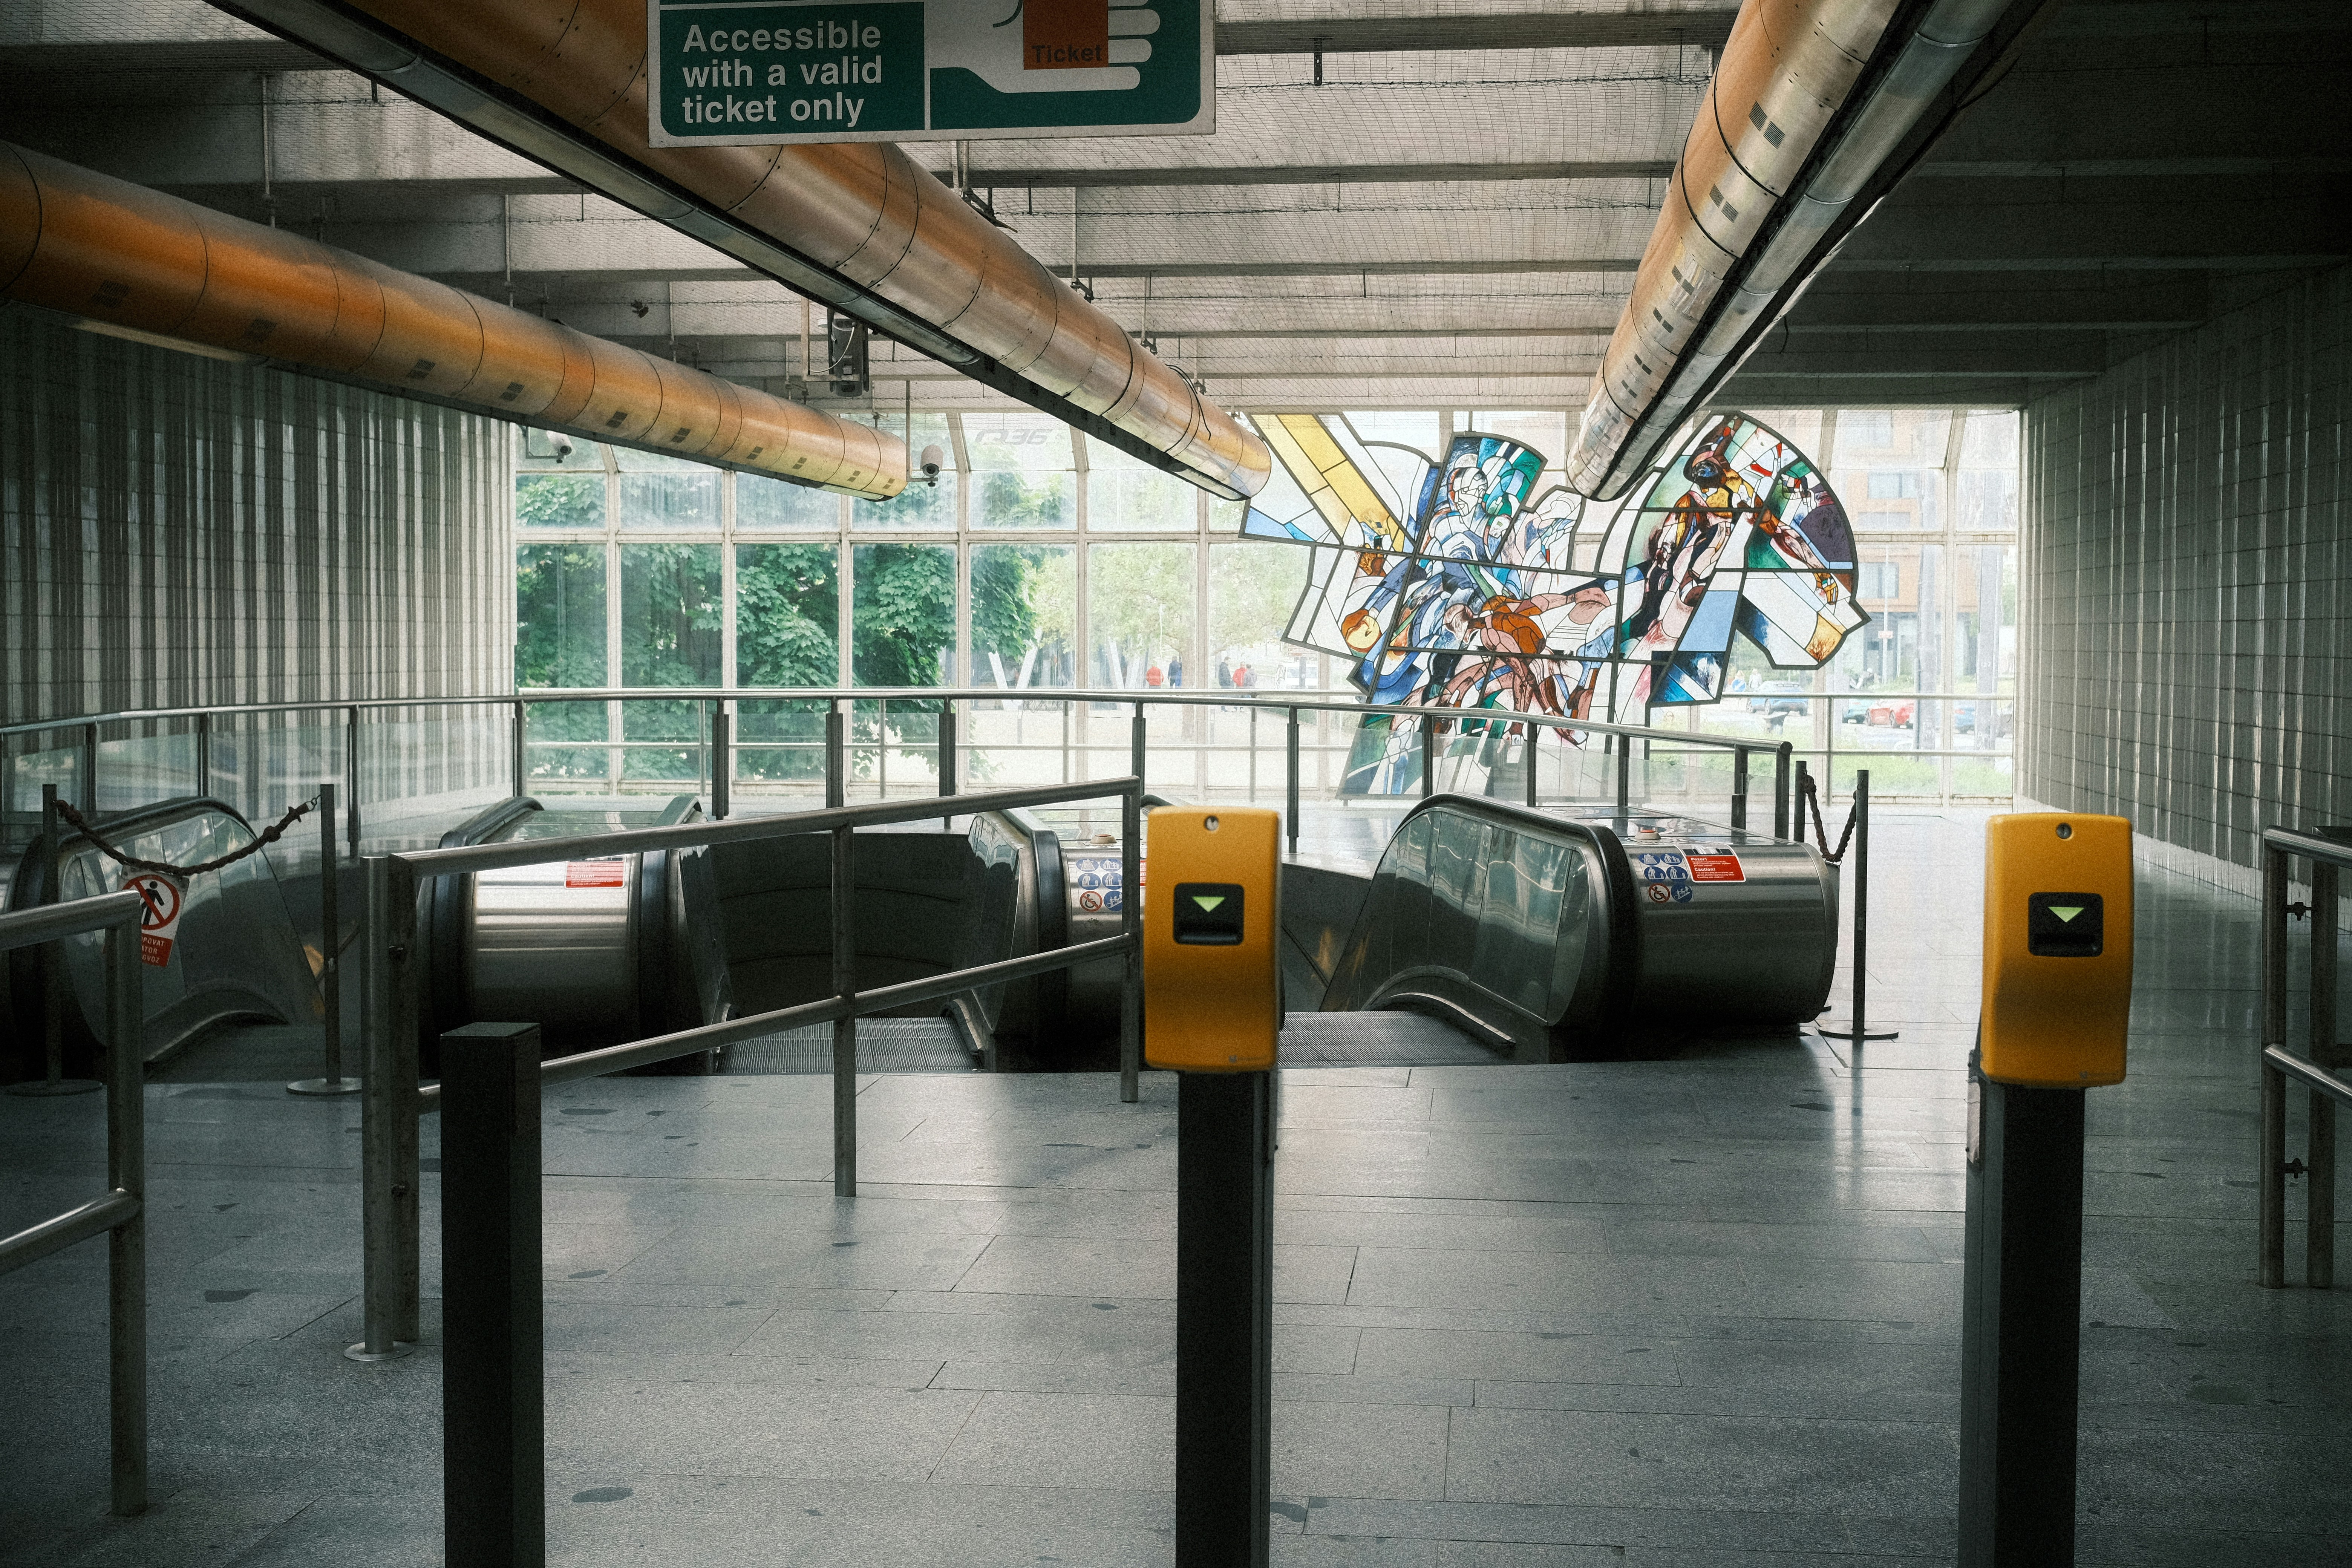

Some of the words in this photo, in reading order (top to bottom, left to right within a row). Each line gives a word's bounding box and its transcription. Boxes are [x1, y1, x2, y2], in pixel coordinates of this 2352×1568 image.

[683, 20, 881, 52] Accessible
[1031, 44, 1102, 63] Ticket
[682, 59, 753, 87] with
[767, 64, 786, 86] a
[799, 55, 882, 85] valid
[682, 95, 776, 124] ticket
[790, 92, 864, 127] only
